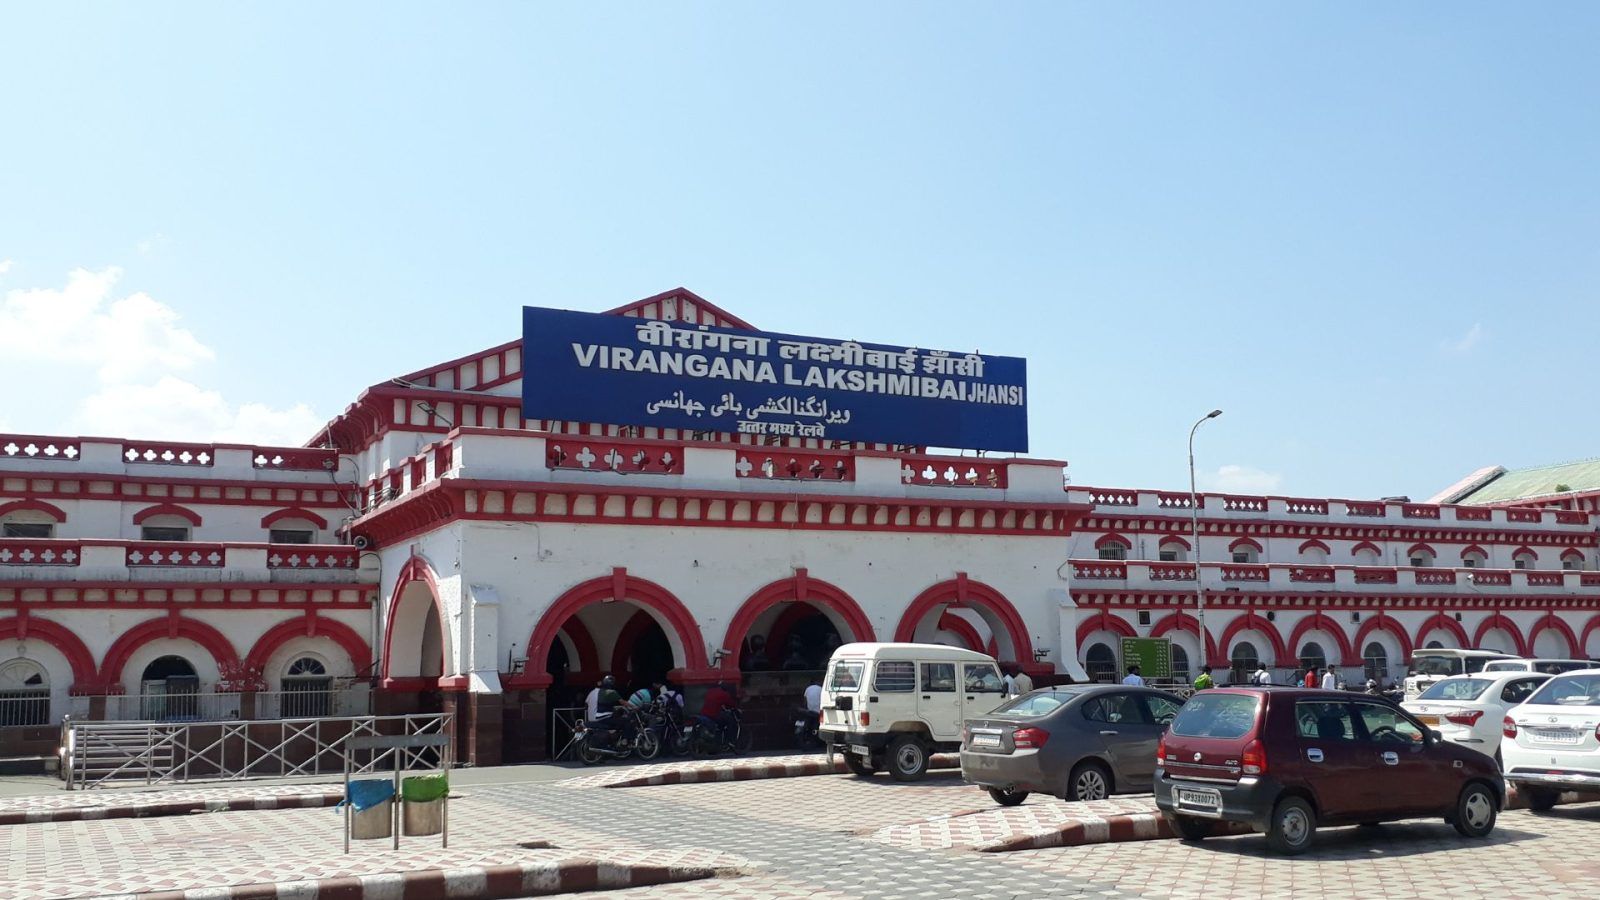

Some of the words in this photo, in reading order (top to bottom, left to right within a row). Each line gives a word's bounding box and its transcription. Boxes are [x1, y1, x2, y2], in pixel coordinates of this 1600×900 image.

[635, 321, 771, 357] वीरांगना
[572, 343, 778, 384] VIRANGANA
[784, 363, 966, 401] LAKSHMIBAI
[967, 382, 1023, 406] JHANSI
[737, 420, 768, 434] उत्तर
[795, 420, 826, 437] रेलवे
